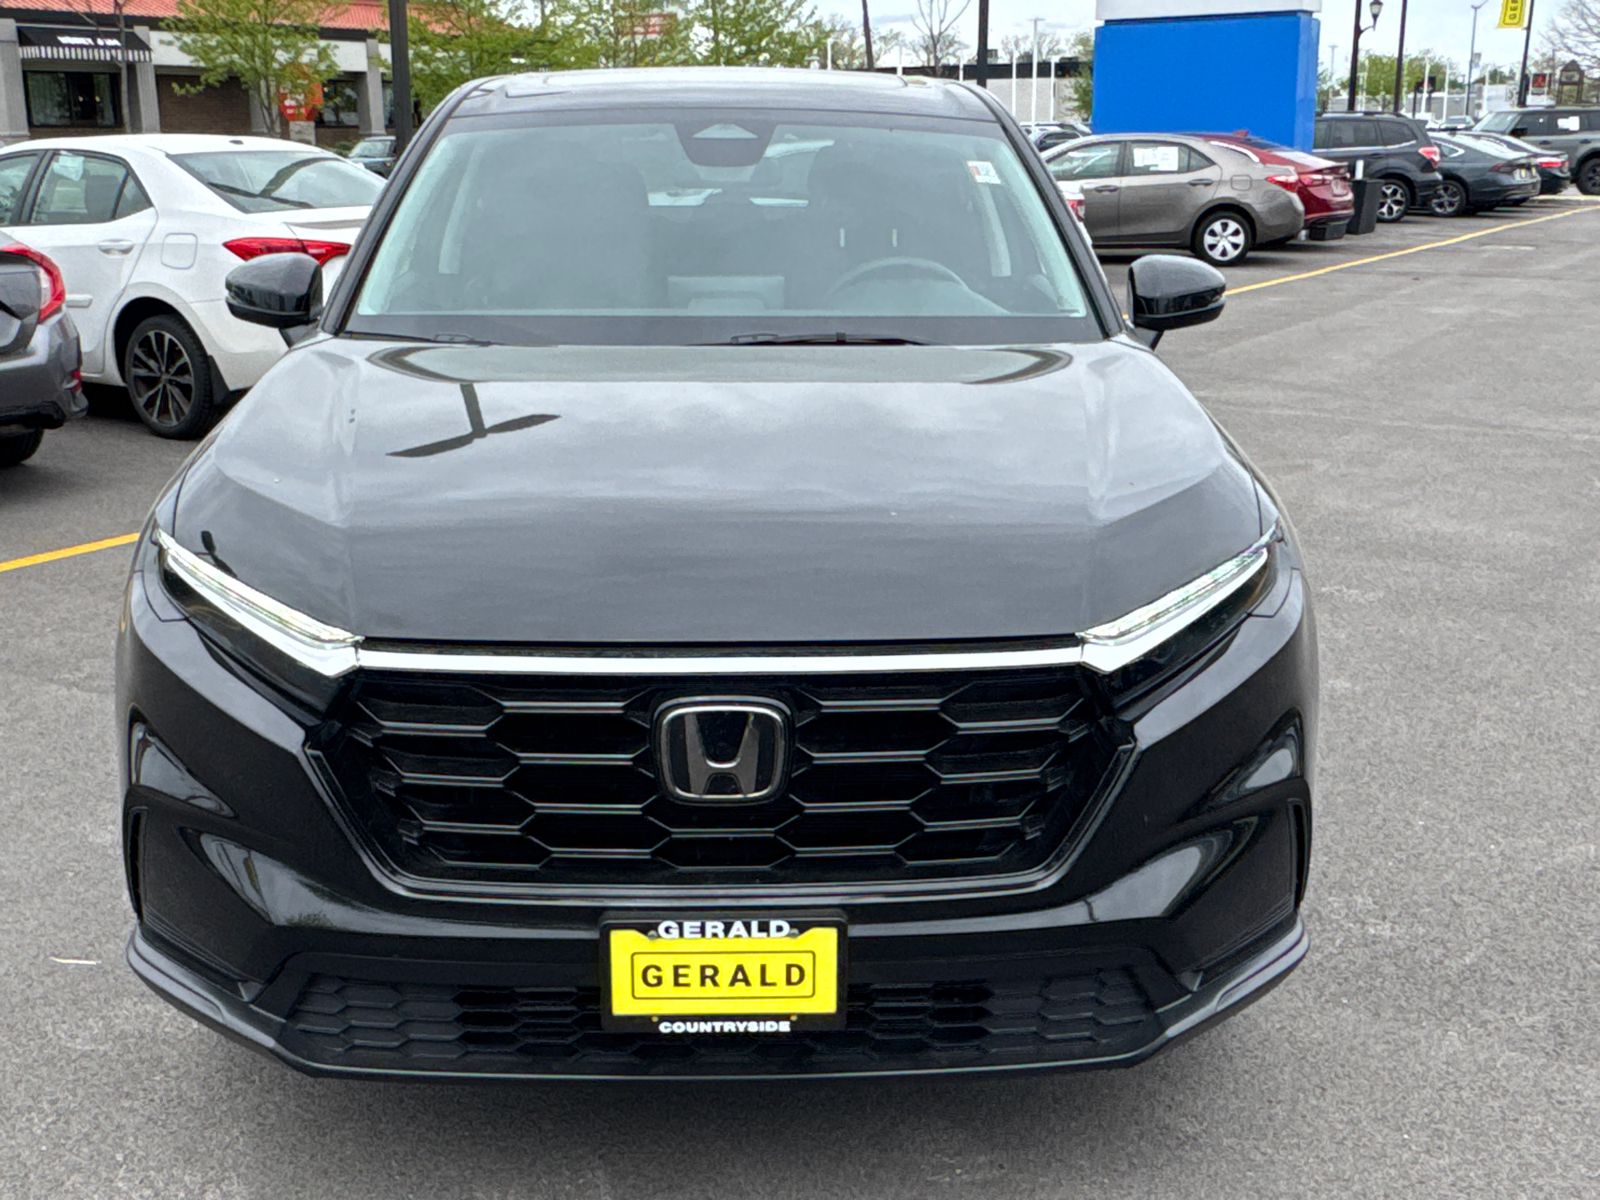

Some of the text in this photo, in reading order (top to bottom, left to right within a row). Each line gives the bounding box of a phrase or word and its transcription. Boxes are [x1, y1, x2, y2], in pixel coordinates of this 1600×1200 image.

[658, 920, 791, 939] GERALD
[641, 964, 806, 987] GERALD
[658, 1021, 791, 1033] COUNTRYSIDE
